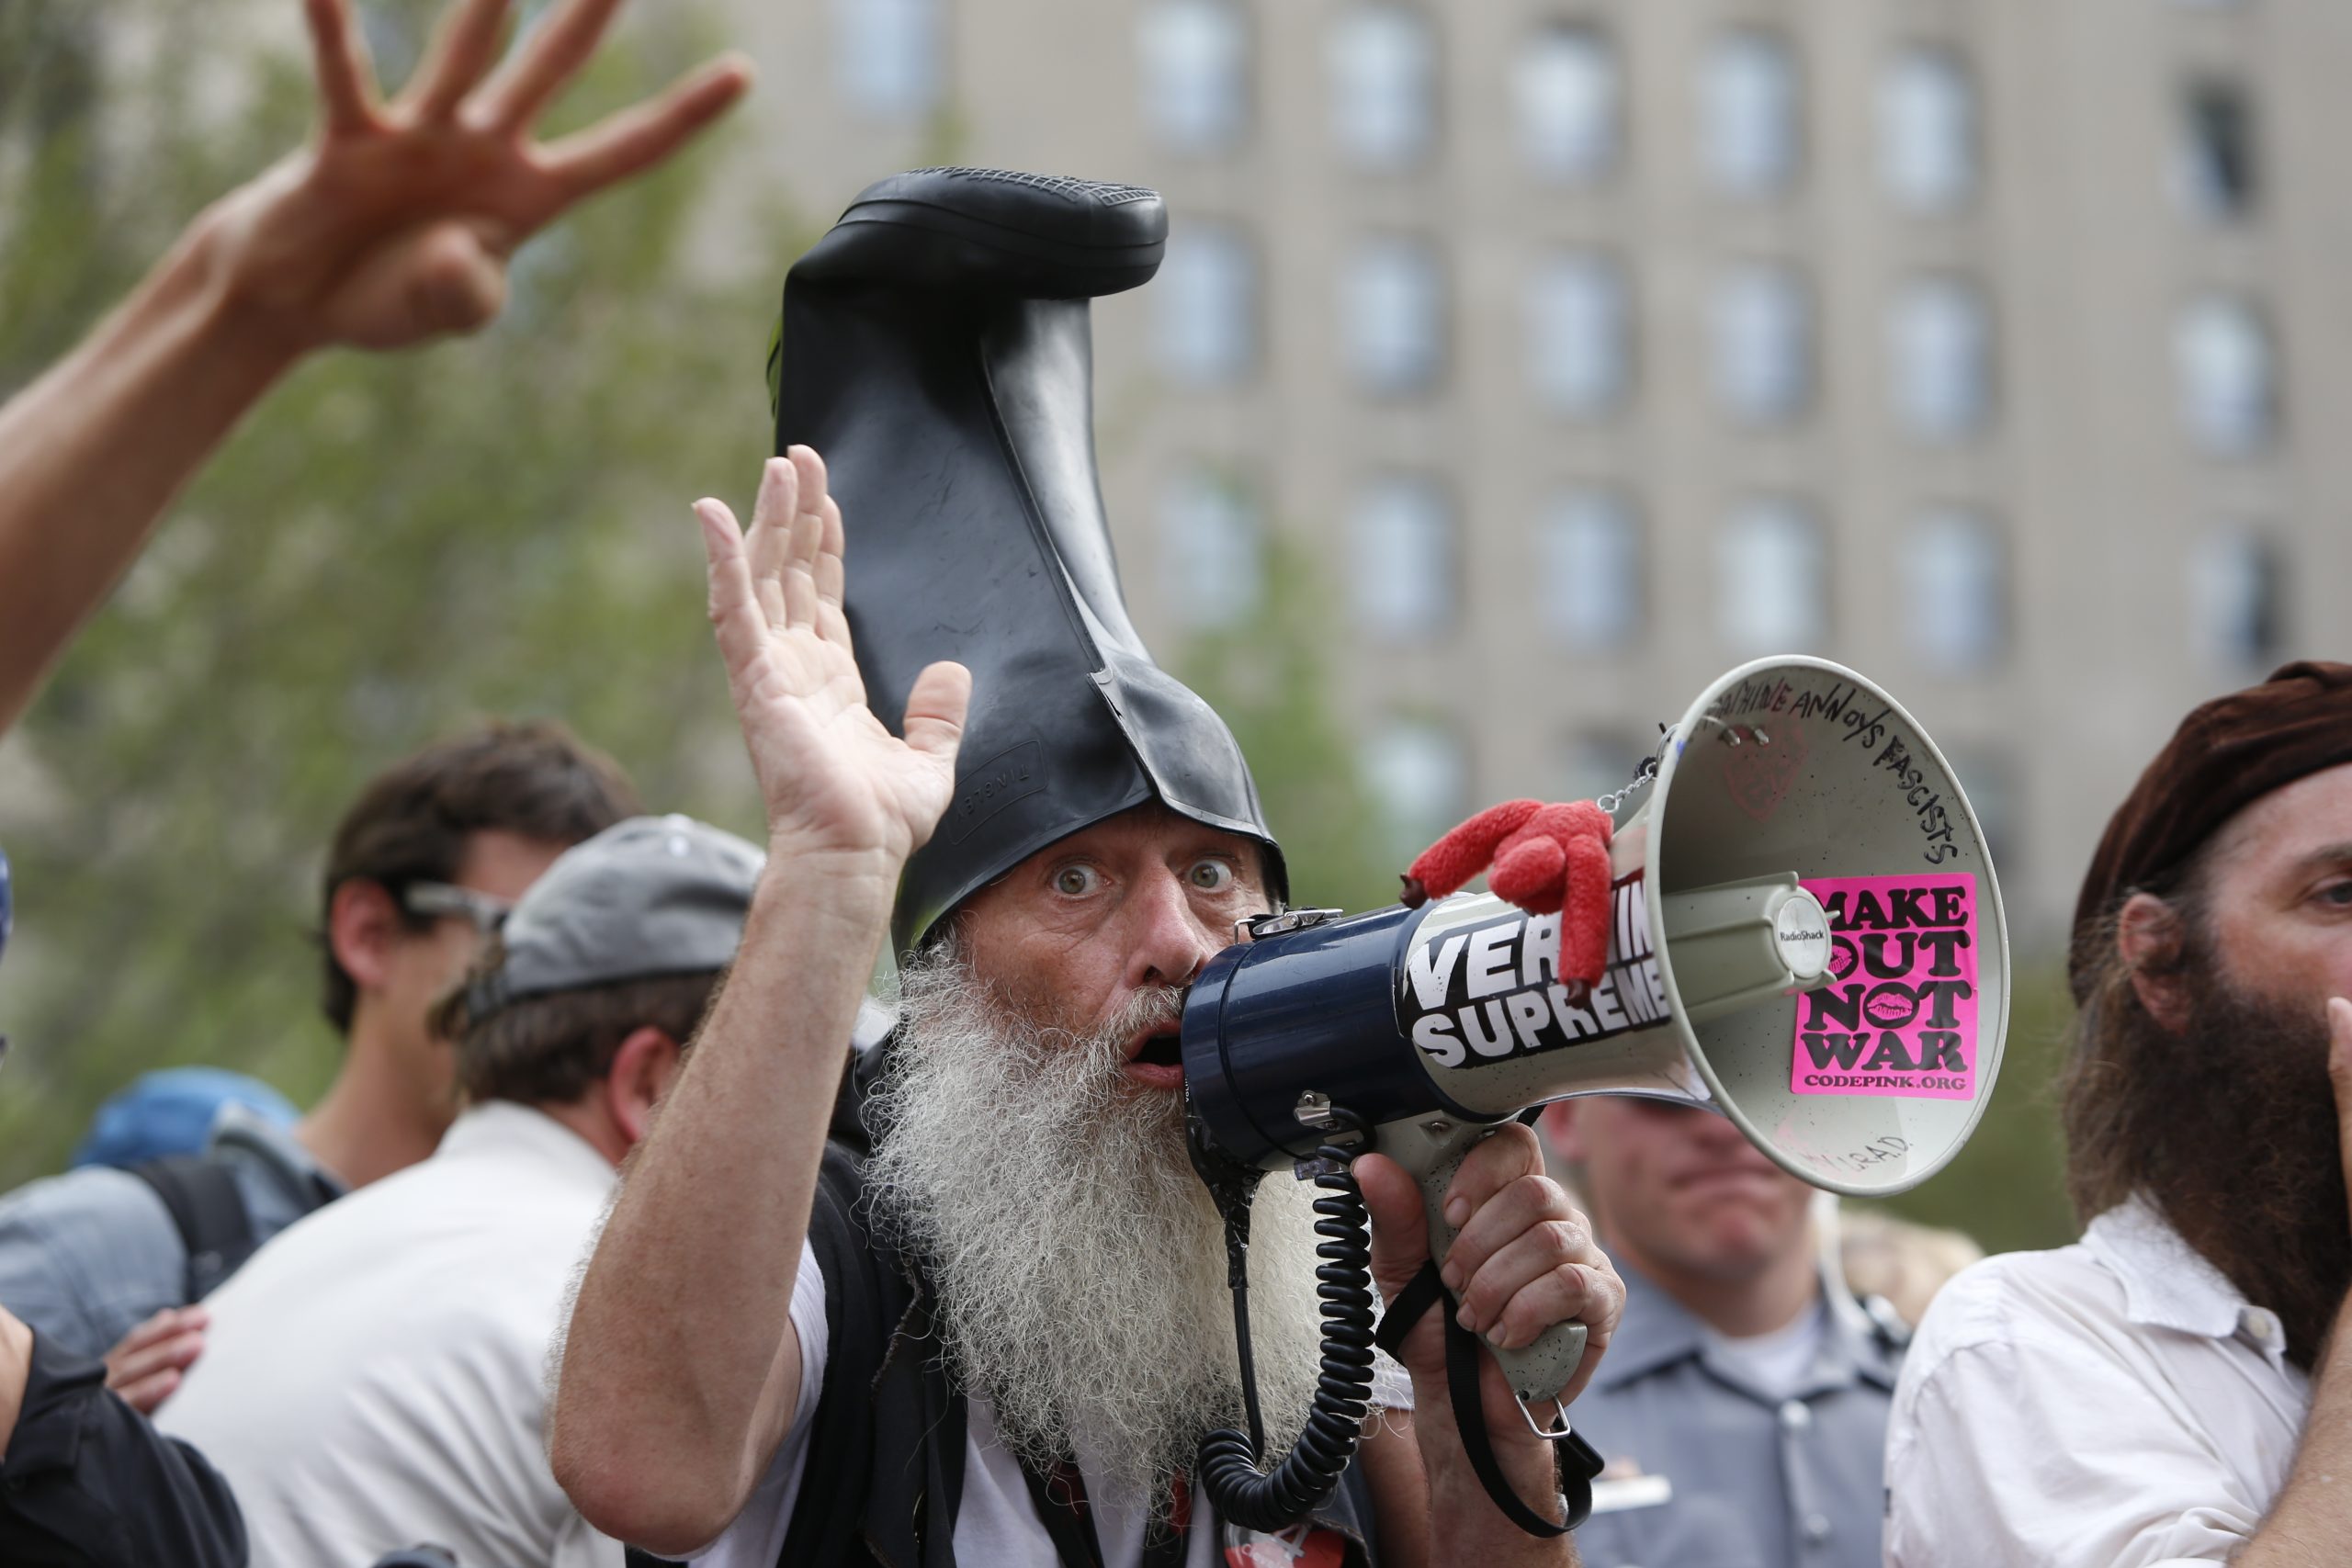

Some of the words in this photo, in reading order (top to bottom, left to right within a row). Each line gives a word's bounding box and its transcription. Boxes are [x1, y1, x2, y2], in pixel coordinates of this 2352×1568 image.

[956, 763, 1031, 822] TINGLEY
[1788, 682, 1891, 749] ANNOYS
[1872, 735, 1958, 864] FASCISTS
[1408, 880, 1654, 1010] VERIN
[1780, 929, 1825, 942] RadioShack
[1411, 960, 1671, 1068] SUPREME
[1803, 980, 1973, 1032] NOT
[1801, 1031, 1969, 1072] WAR
[1804, 1075, 1967, 1091] CODEPINK.ORG
